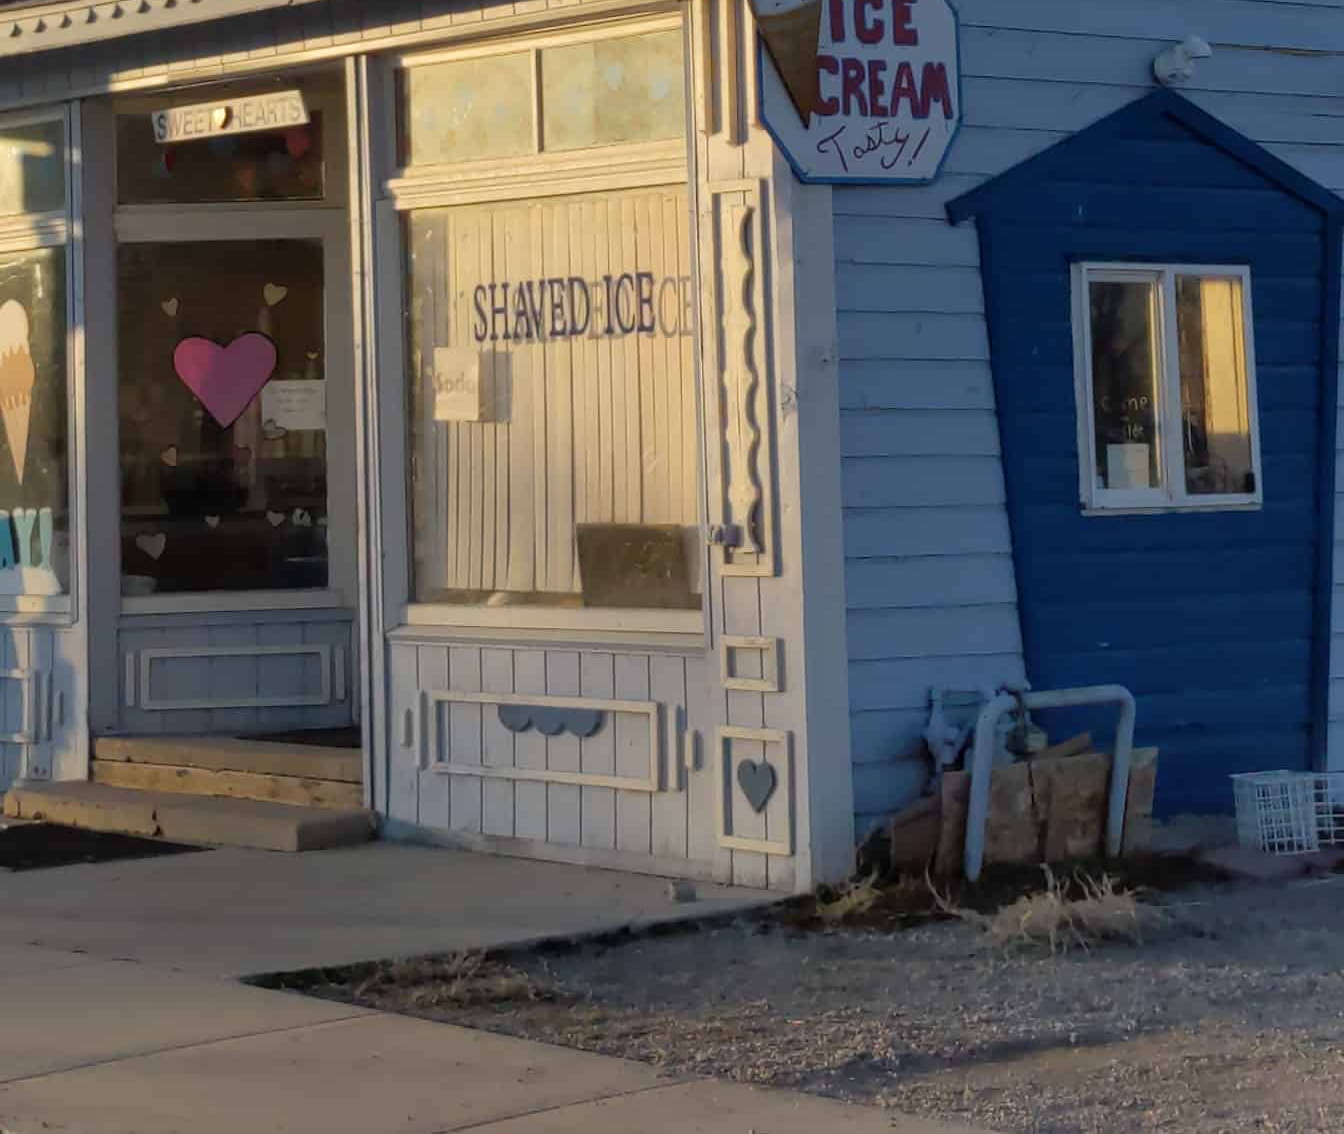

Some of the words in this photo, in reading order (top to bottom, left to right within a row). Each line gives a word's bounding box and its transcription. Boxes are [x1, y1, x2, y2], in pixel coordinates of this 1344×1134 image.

[813, 54, 954, 120] CREAM
[816, 121, 930, 173] Tasty!
[473, 275, 591, 343] SHAVED
[602, 271, 656, 336] ICE
